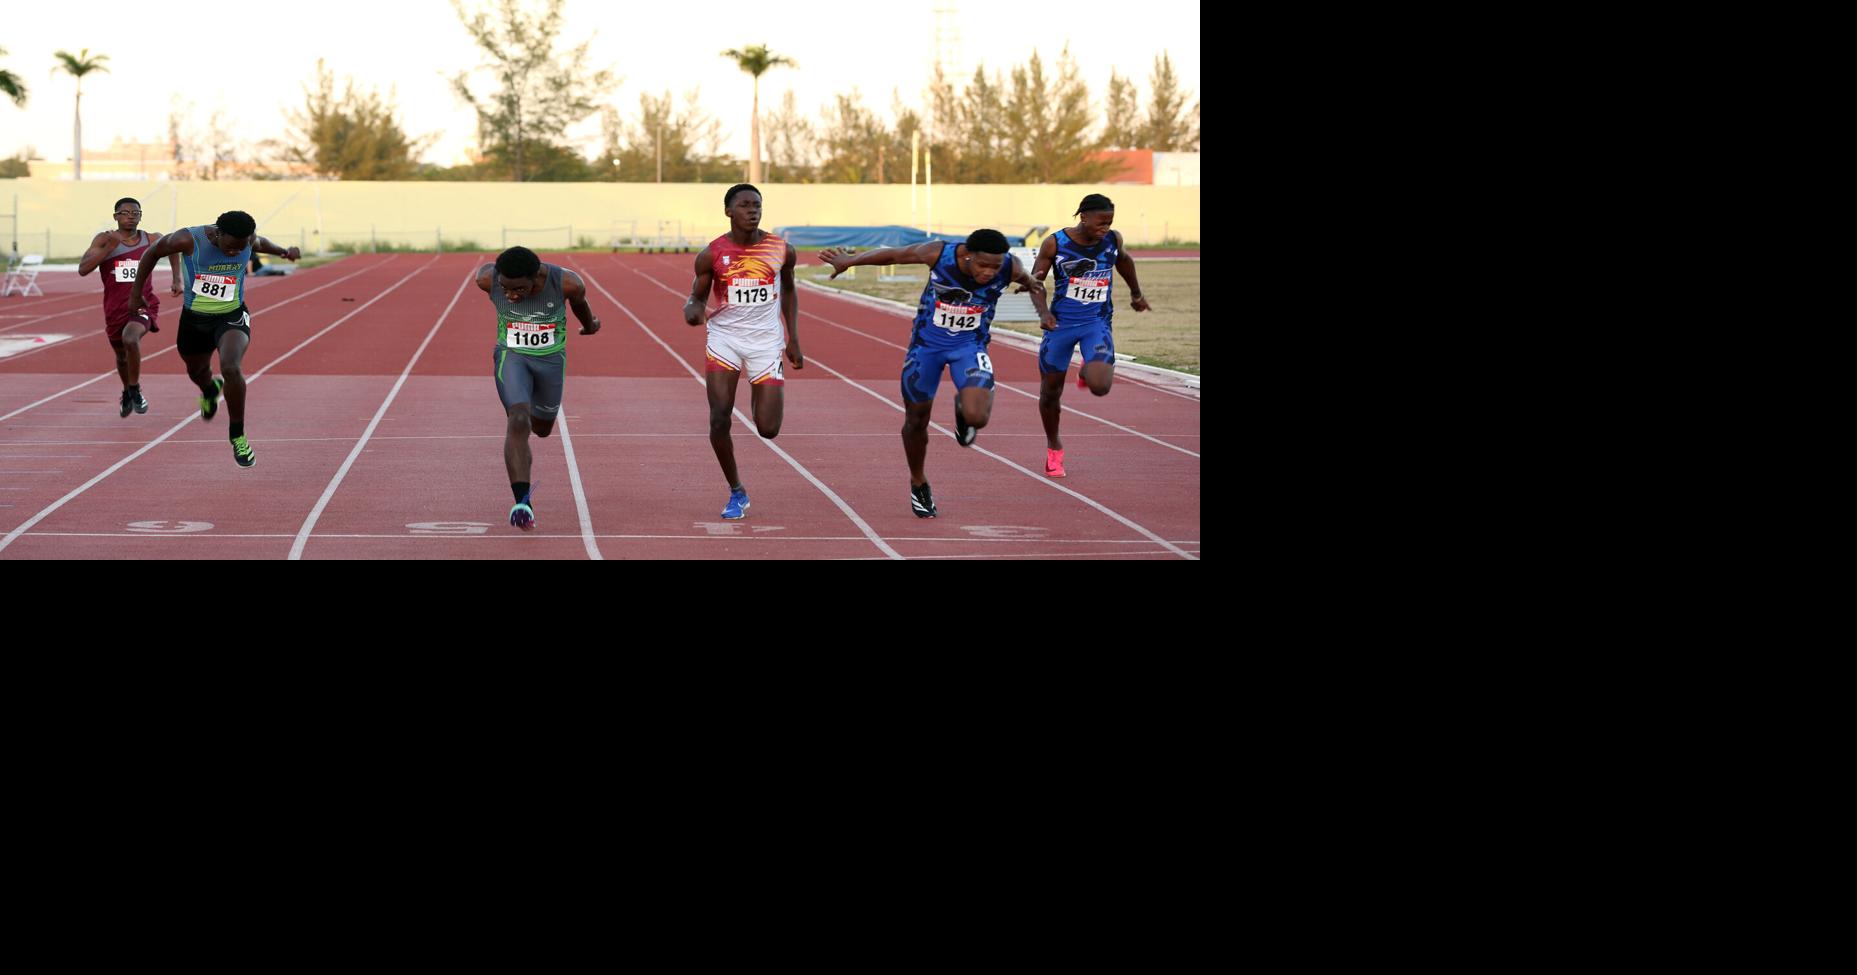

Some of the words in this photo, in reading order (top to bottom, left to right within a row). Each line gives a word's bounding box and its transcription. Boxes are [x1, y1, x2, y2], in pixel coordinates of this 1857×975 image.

[201, 282, 227, 298] 881
[732, 278, 760, 287] PUMA
[735, 287, 768, 303] 1179
[1074, 286, 1102, 300] 1141
[941, 313, 975, 328] 1142
[514, 331, 549, 346] 1108
